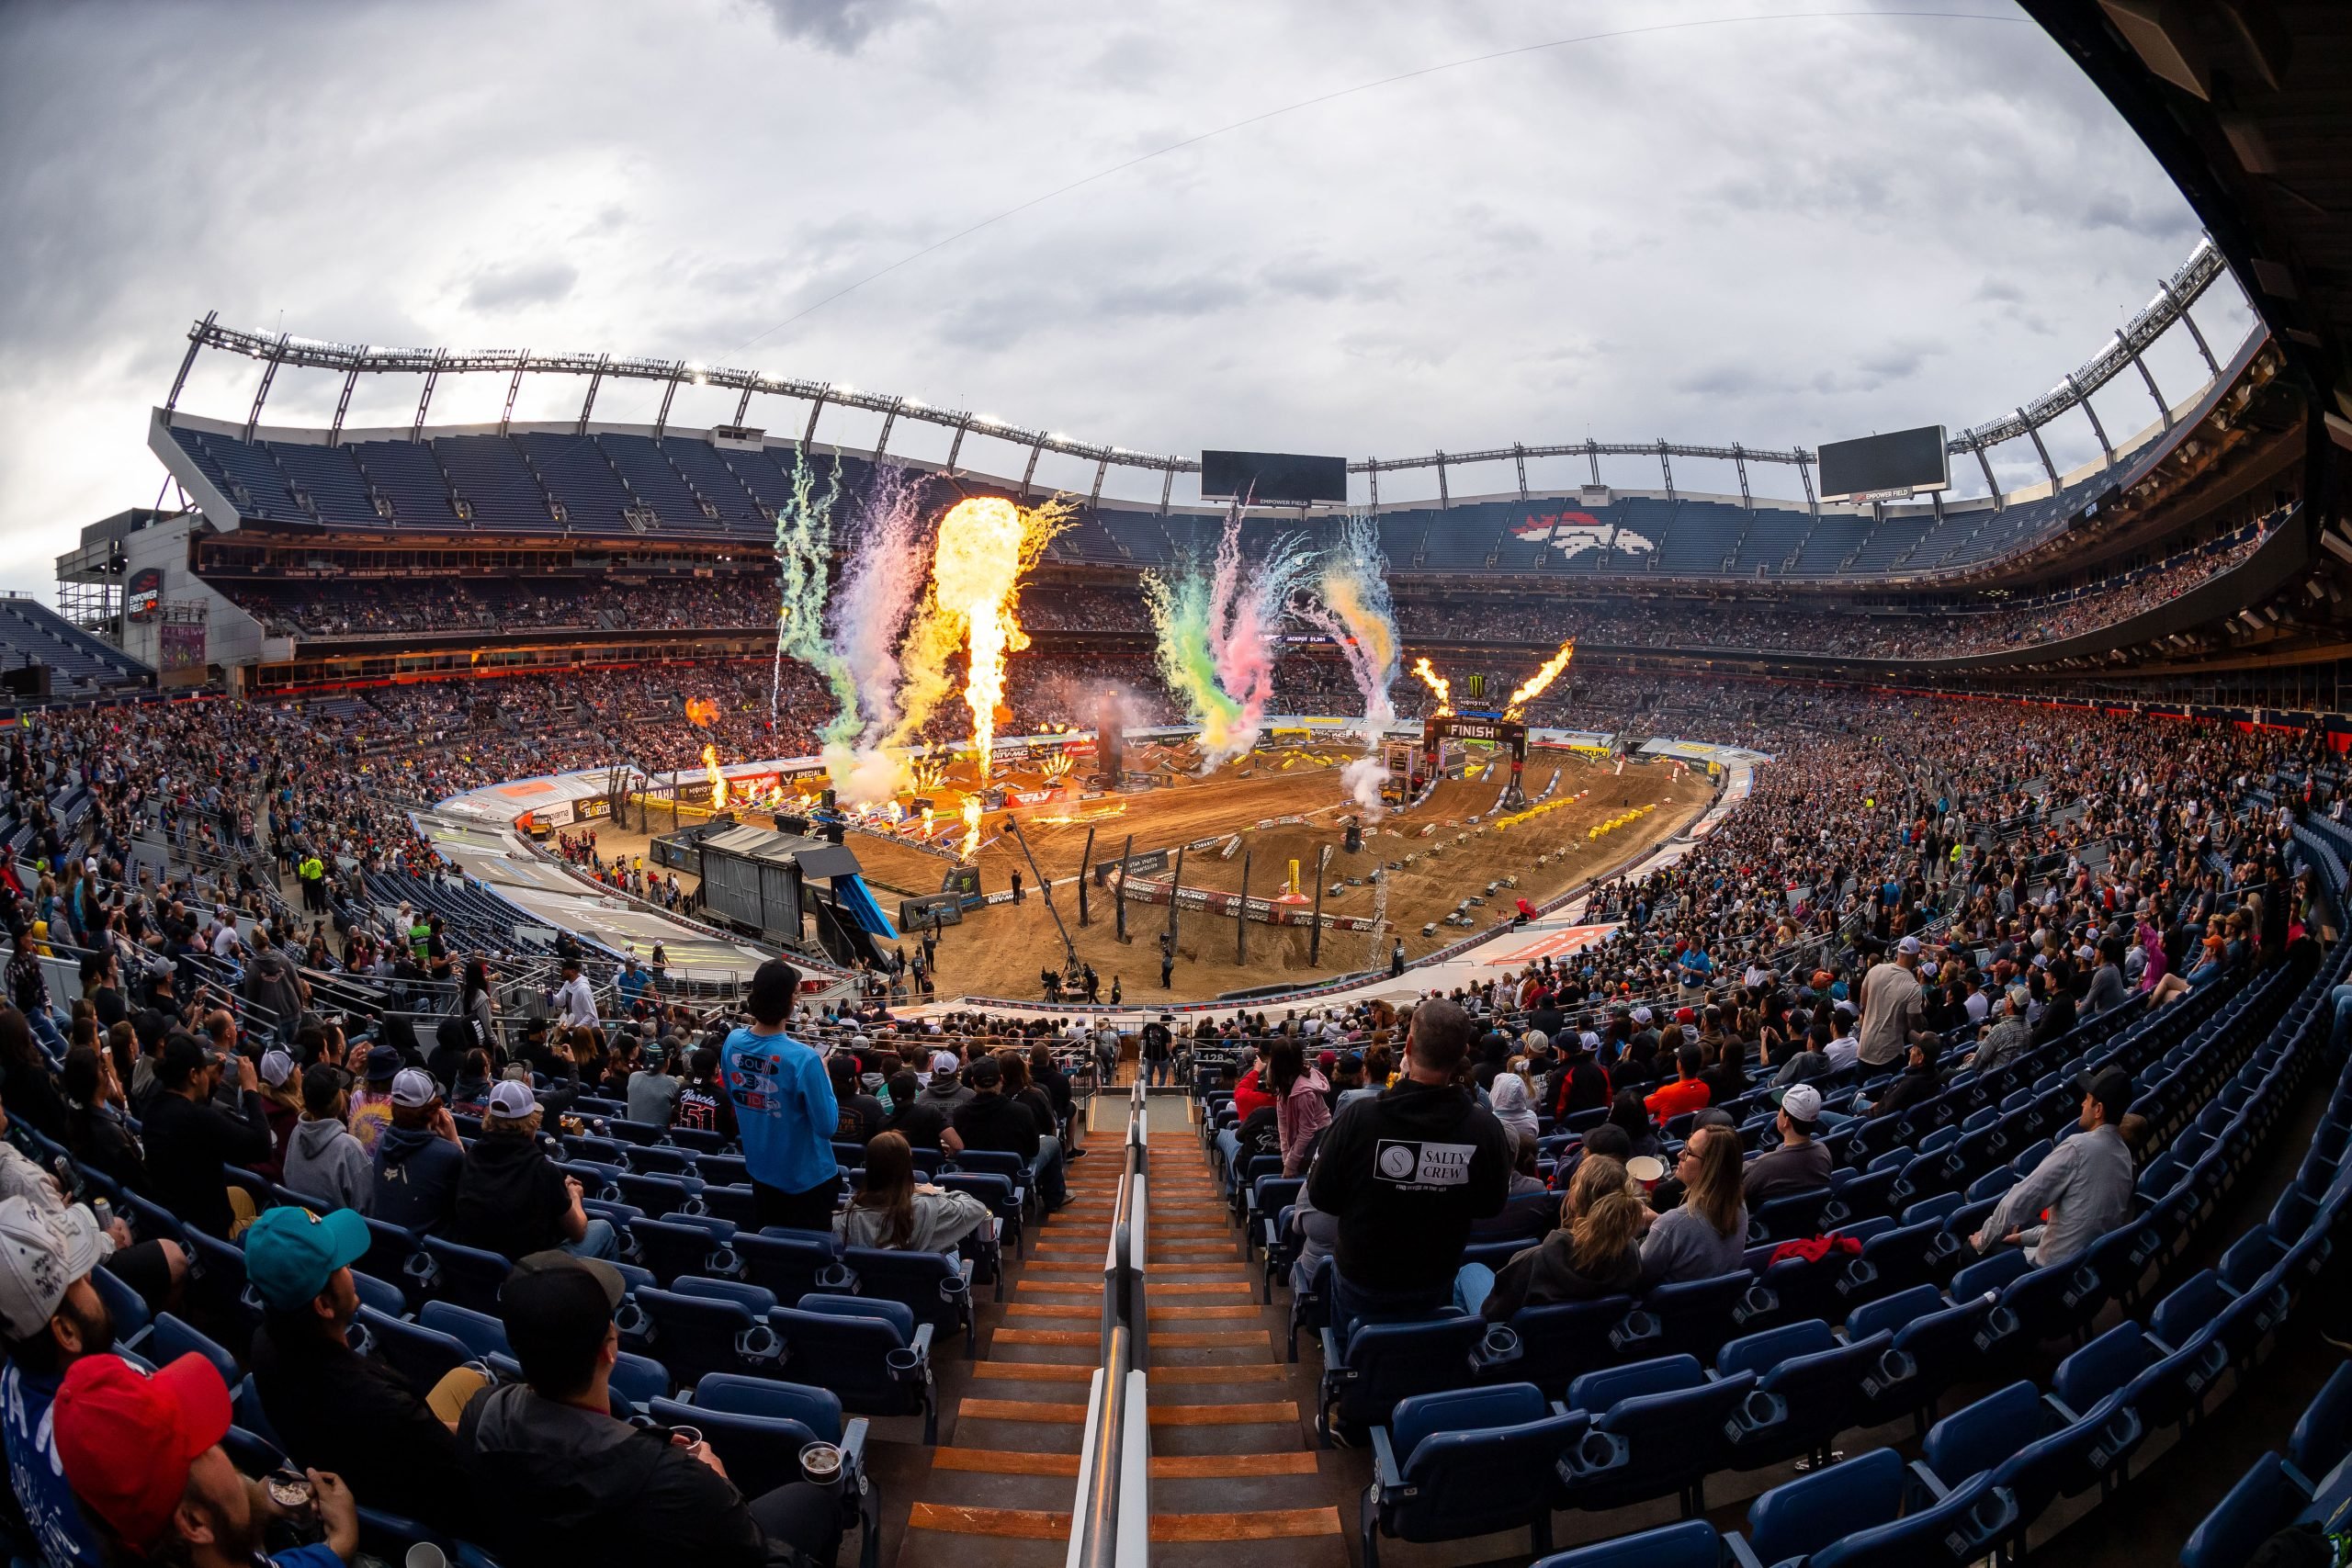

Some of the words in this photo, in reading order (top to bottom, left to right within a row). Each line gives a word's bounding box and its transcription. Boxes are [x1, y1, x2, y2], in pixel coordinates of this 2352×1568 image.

[1866, 491, 1892, 500] EMPOWER
[130, 589, 157, 604] EMPOWER
[1451, 724, 1495, 739] FINISH
[797, 770, 821, 779] SPECIAL
[1013, 791, 1052, 804] FLY
[1194, 839, 1218, 849] OAKLEY
[1142, 856, 1158, 865] SPORTS
[1130, 863, 1158, 874] COMMISSION
[1204, 1054, 1224, 1062] 128
[680, 1089, 719, 1108] Barcia
[680, 1102, 715, 1132] 51
[1390, 1151, 1404, 1173] S
[1424, 1150, 1467, 1165] SALTY
[1423, 1166, 1463, 1179] CREW
